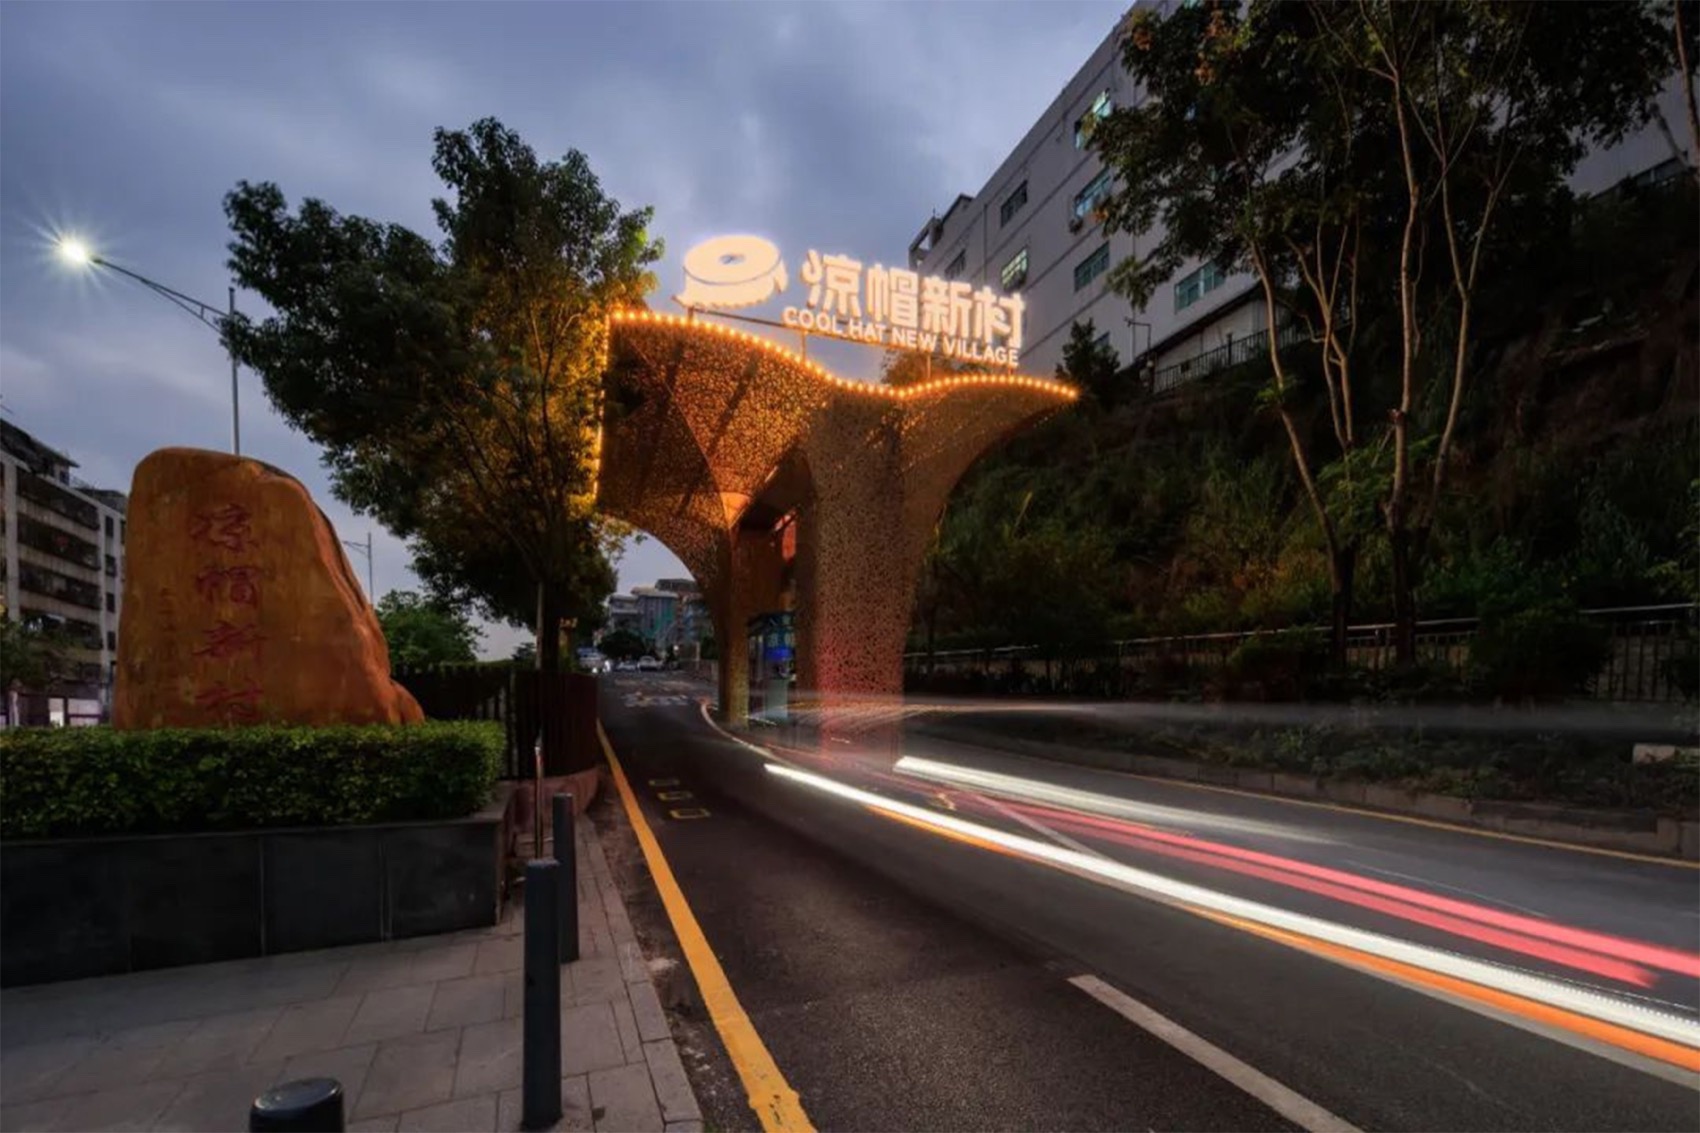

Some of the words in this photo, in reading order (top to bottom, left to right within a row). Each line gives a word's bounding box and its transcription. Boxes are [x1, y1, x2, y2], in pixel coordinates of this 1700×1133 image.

[782, 306, 843, 334] COOL
[848, 317, 886, 342] HAT
[891, 327, 937, 352] NEW
[942, 335, 1019, 369] VILLAGE
